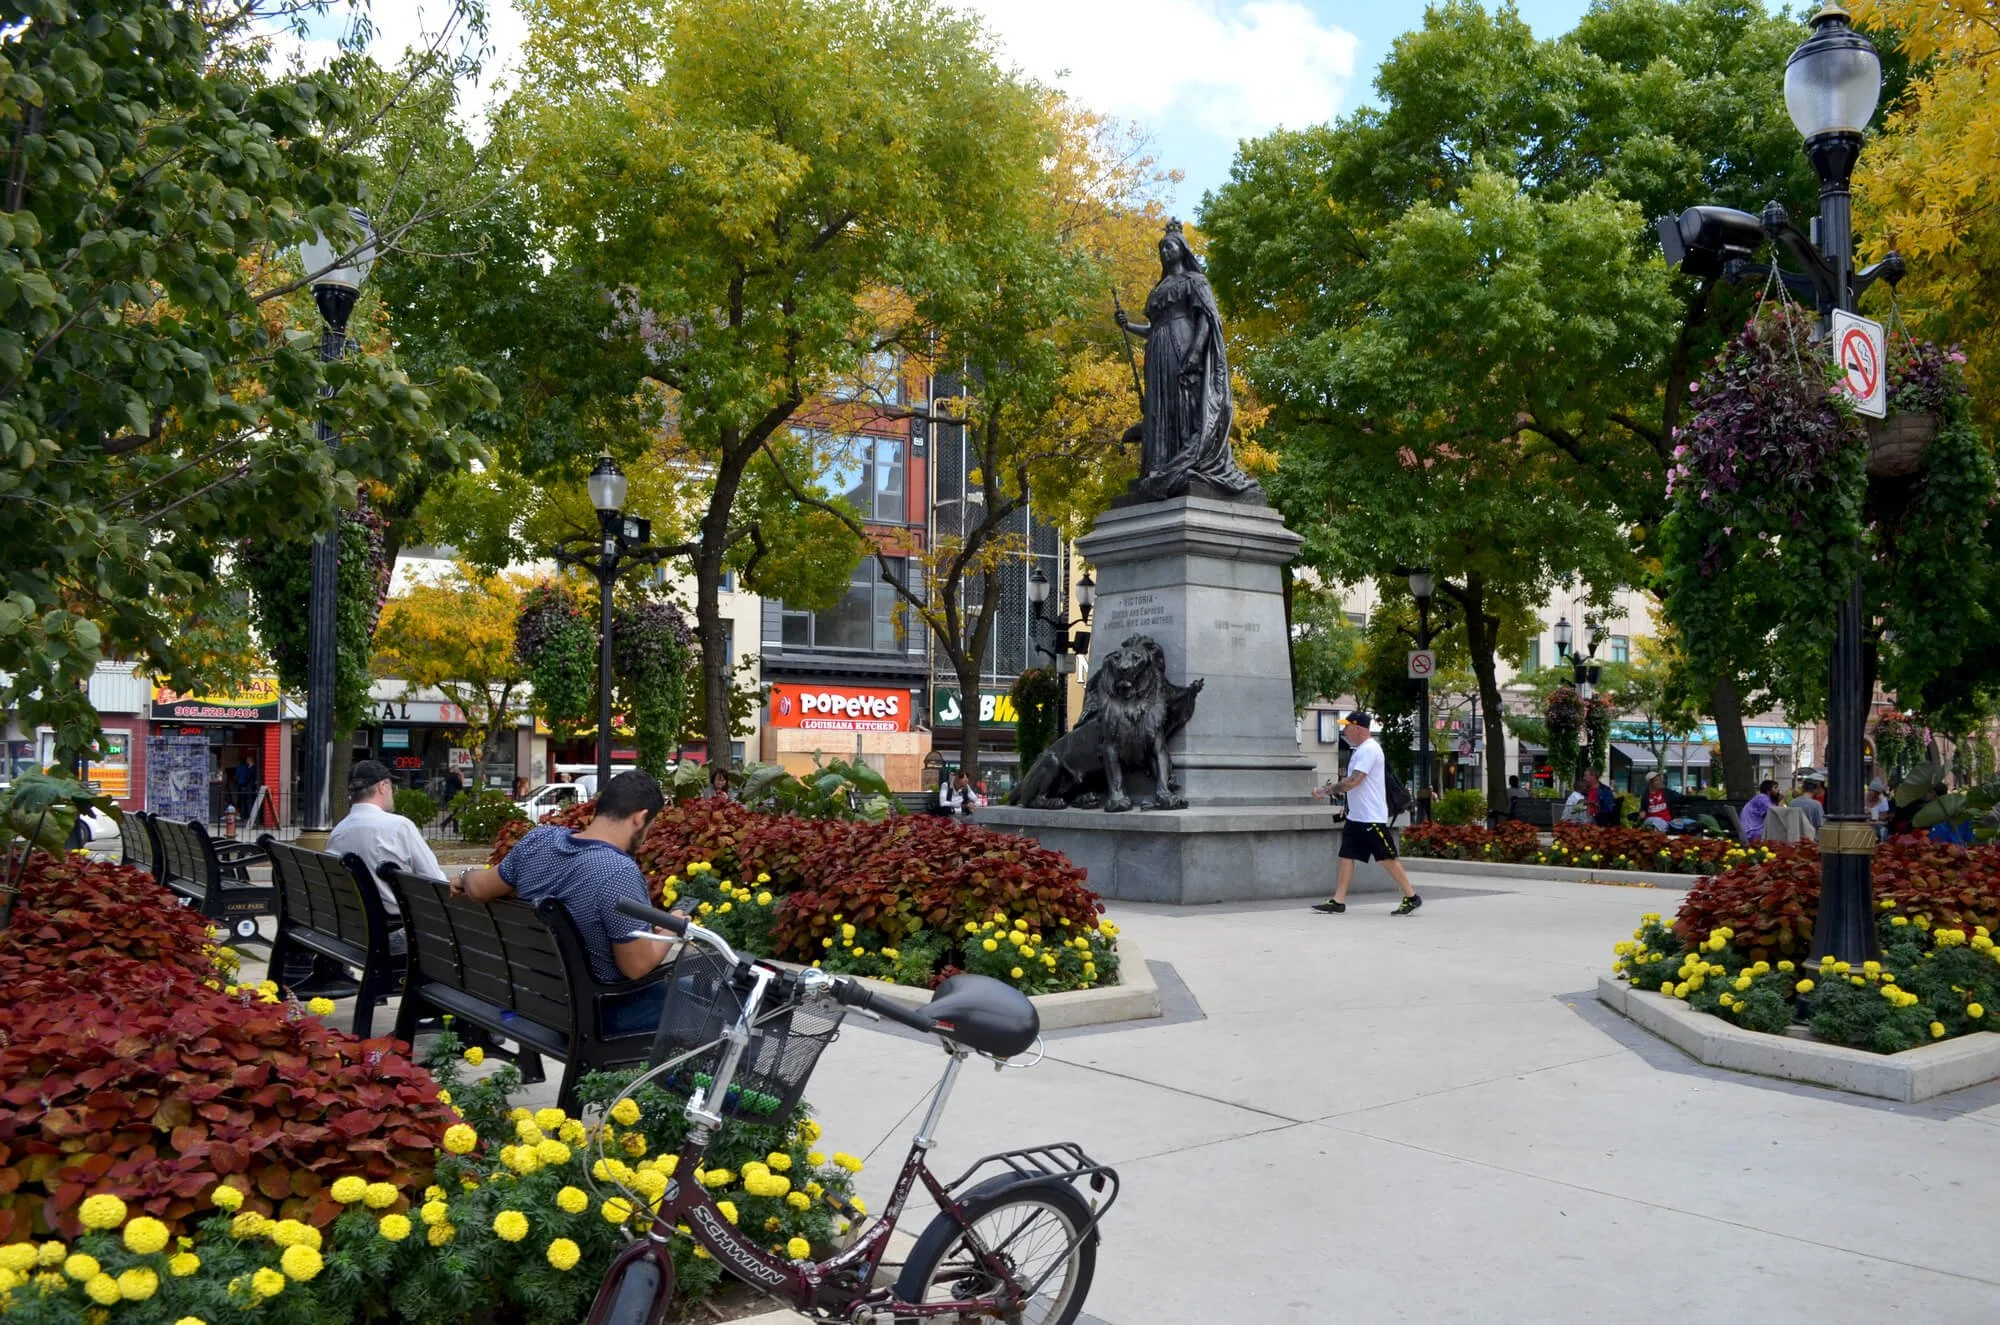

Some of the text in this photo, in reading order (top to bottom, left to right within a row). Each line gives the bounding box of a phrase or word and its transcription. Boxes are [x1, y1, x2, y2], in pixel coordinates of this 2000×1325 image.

[1124, 595, 1153, 607] VICTORIA
[372, 703, 411, 720] TAL
[939, 694, 1021, 722] SBW
[805, 721, 894, 731] LOUISIANA KITCHEN
[395, 757, 422, 769] OPEN
[693, 1204, 787, 1285] SCHWINN
